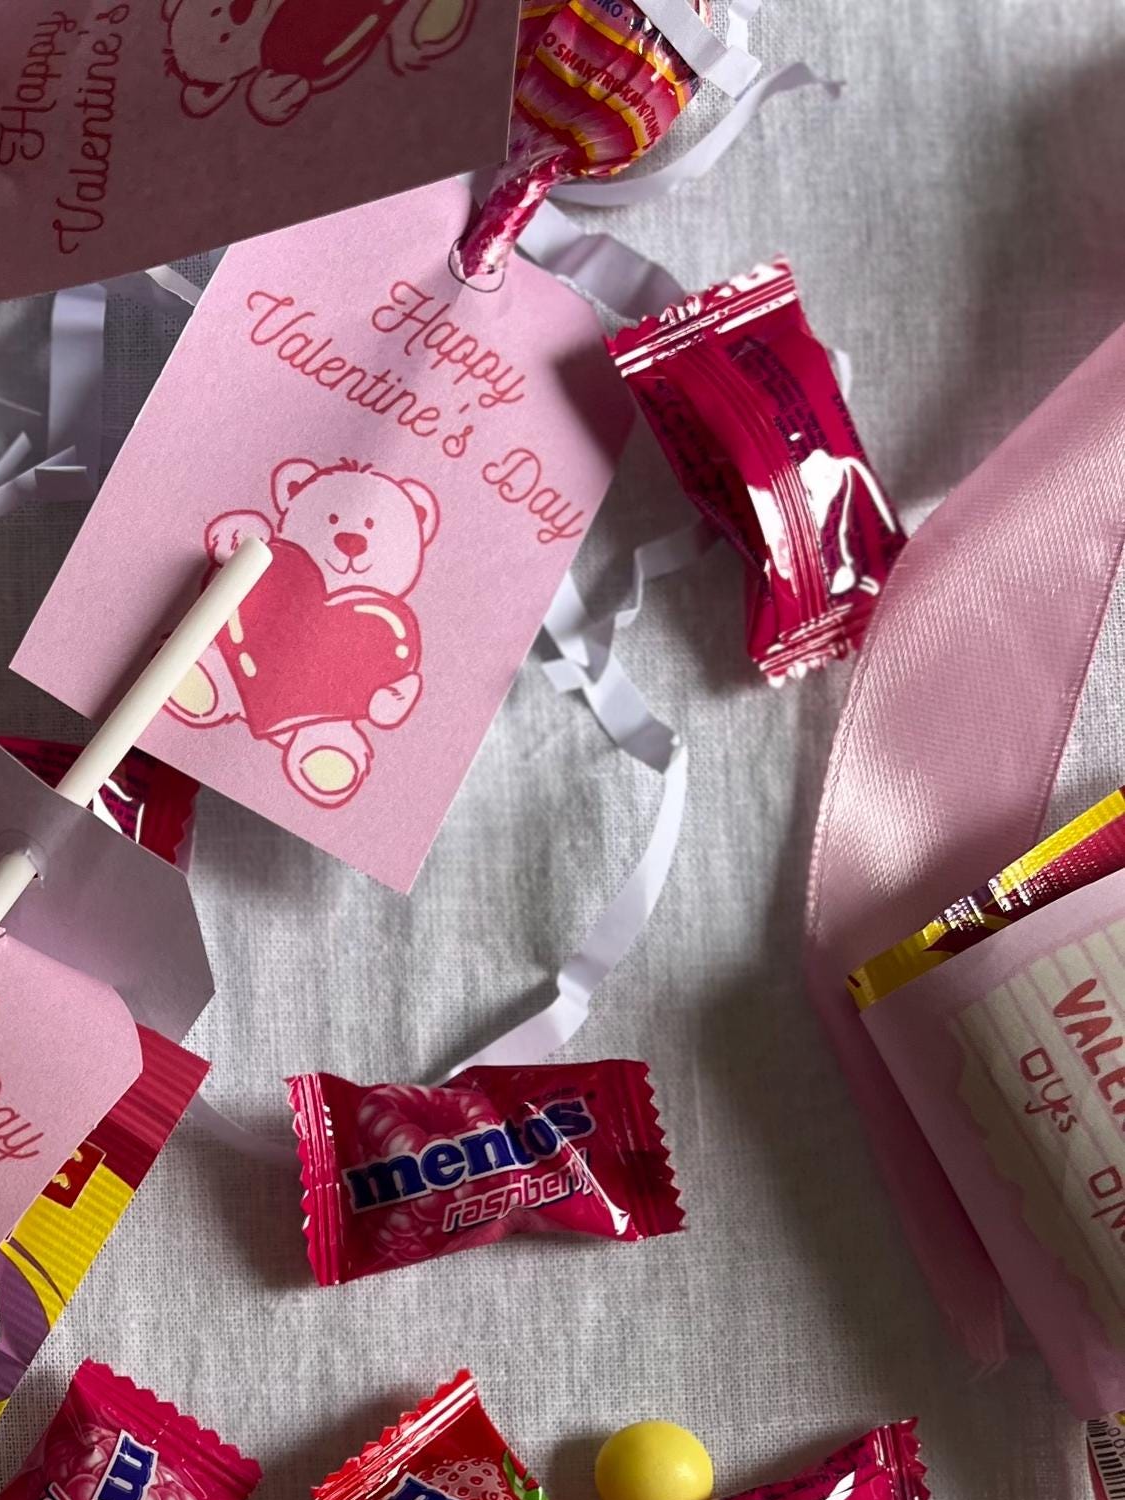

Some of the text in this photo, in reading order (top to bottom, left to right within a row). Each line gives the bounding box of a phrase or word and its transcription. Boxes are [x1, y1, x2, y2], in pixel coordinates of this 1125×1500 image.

[53, 3, 130, 255] Valentine's
[247, 289, 474, 460] Valentine's
[482, 448, 583, 544] Day
[372, 280, 524, 407] Happy
[342, 1097, 597, 1213] mentos
